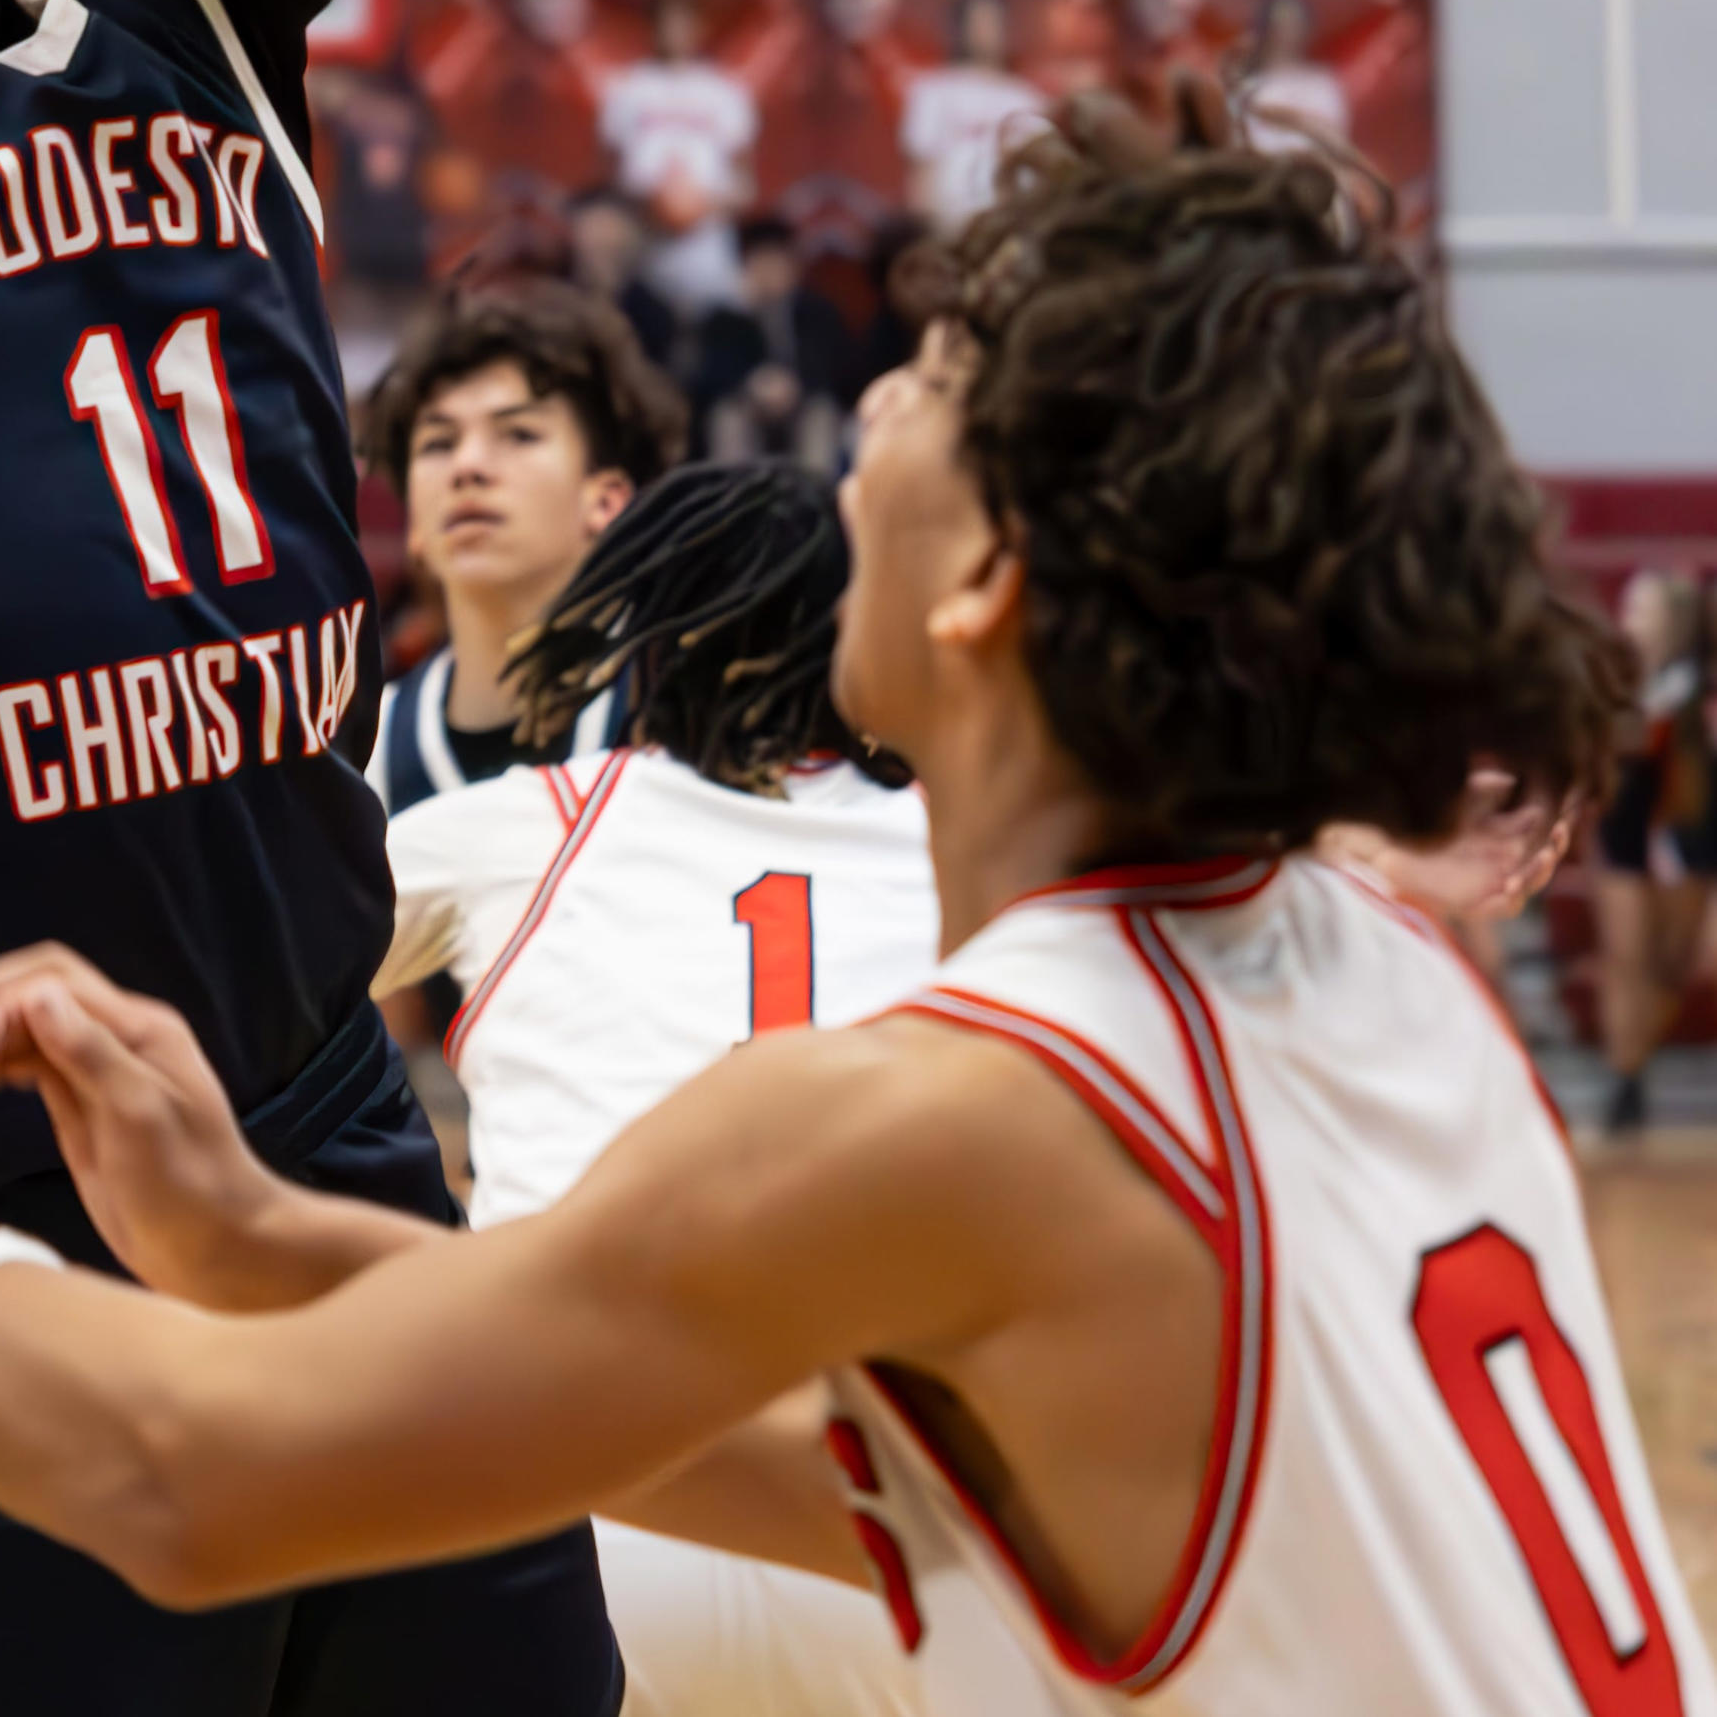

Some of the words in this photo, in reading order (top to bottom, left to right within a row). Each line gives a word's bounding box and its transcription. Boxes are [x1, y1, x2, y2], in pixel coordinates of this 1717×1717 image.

[63, 306, 276, 600] 11
[731, 870, 815, 1046] 1
[1408, 1220, 1686, 1717] 0
